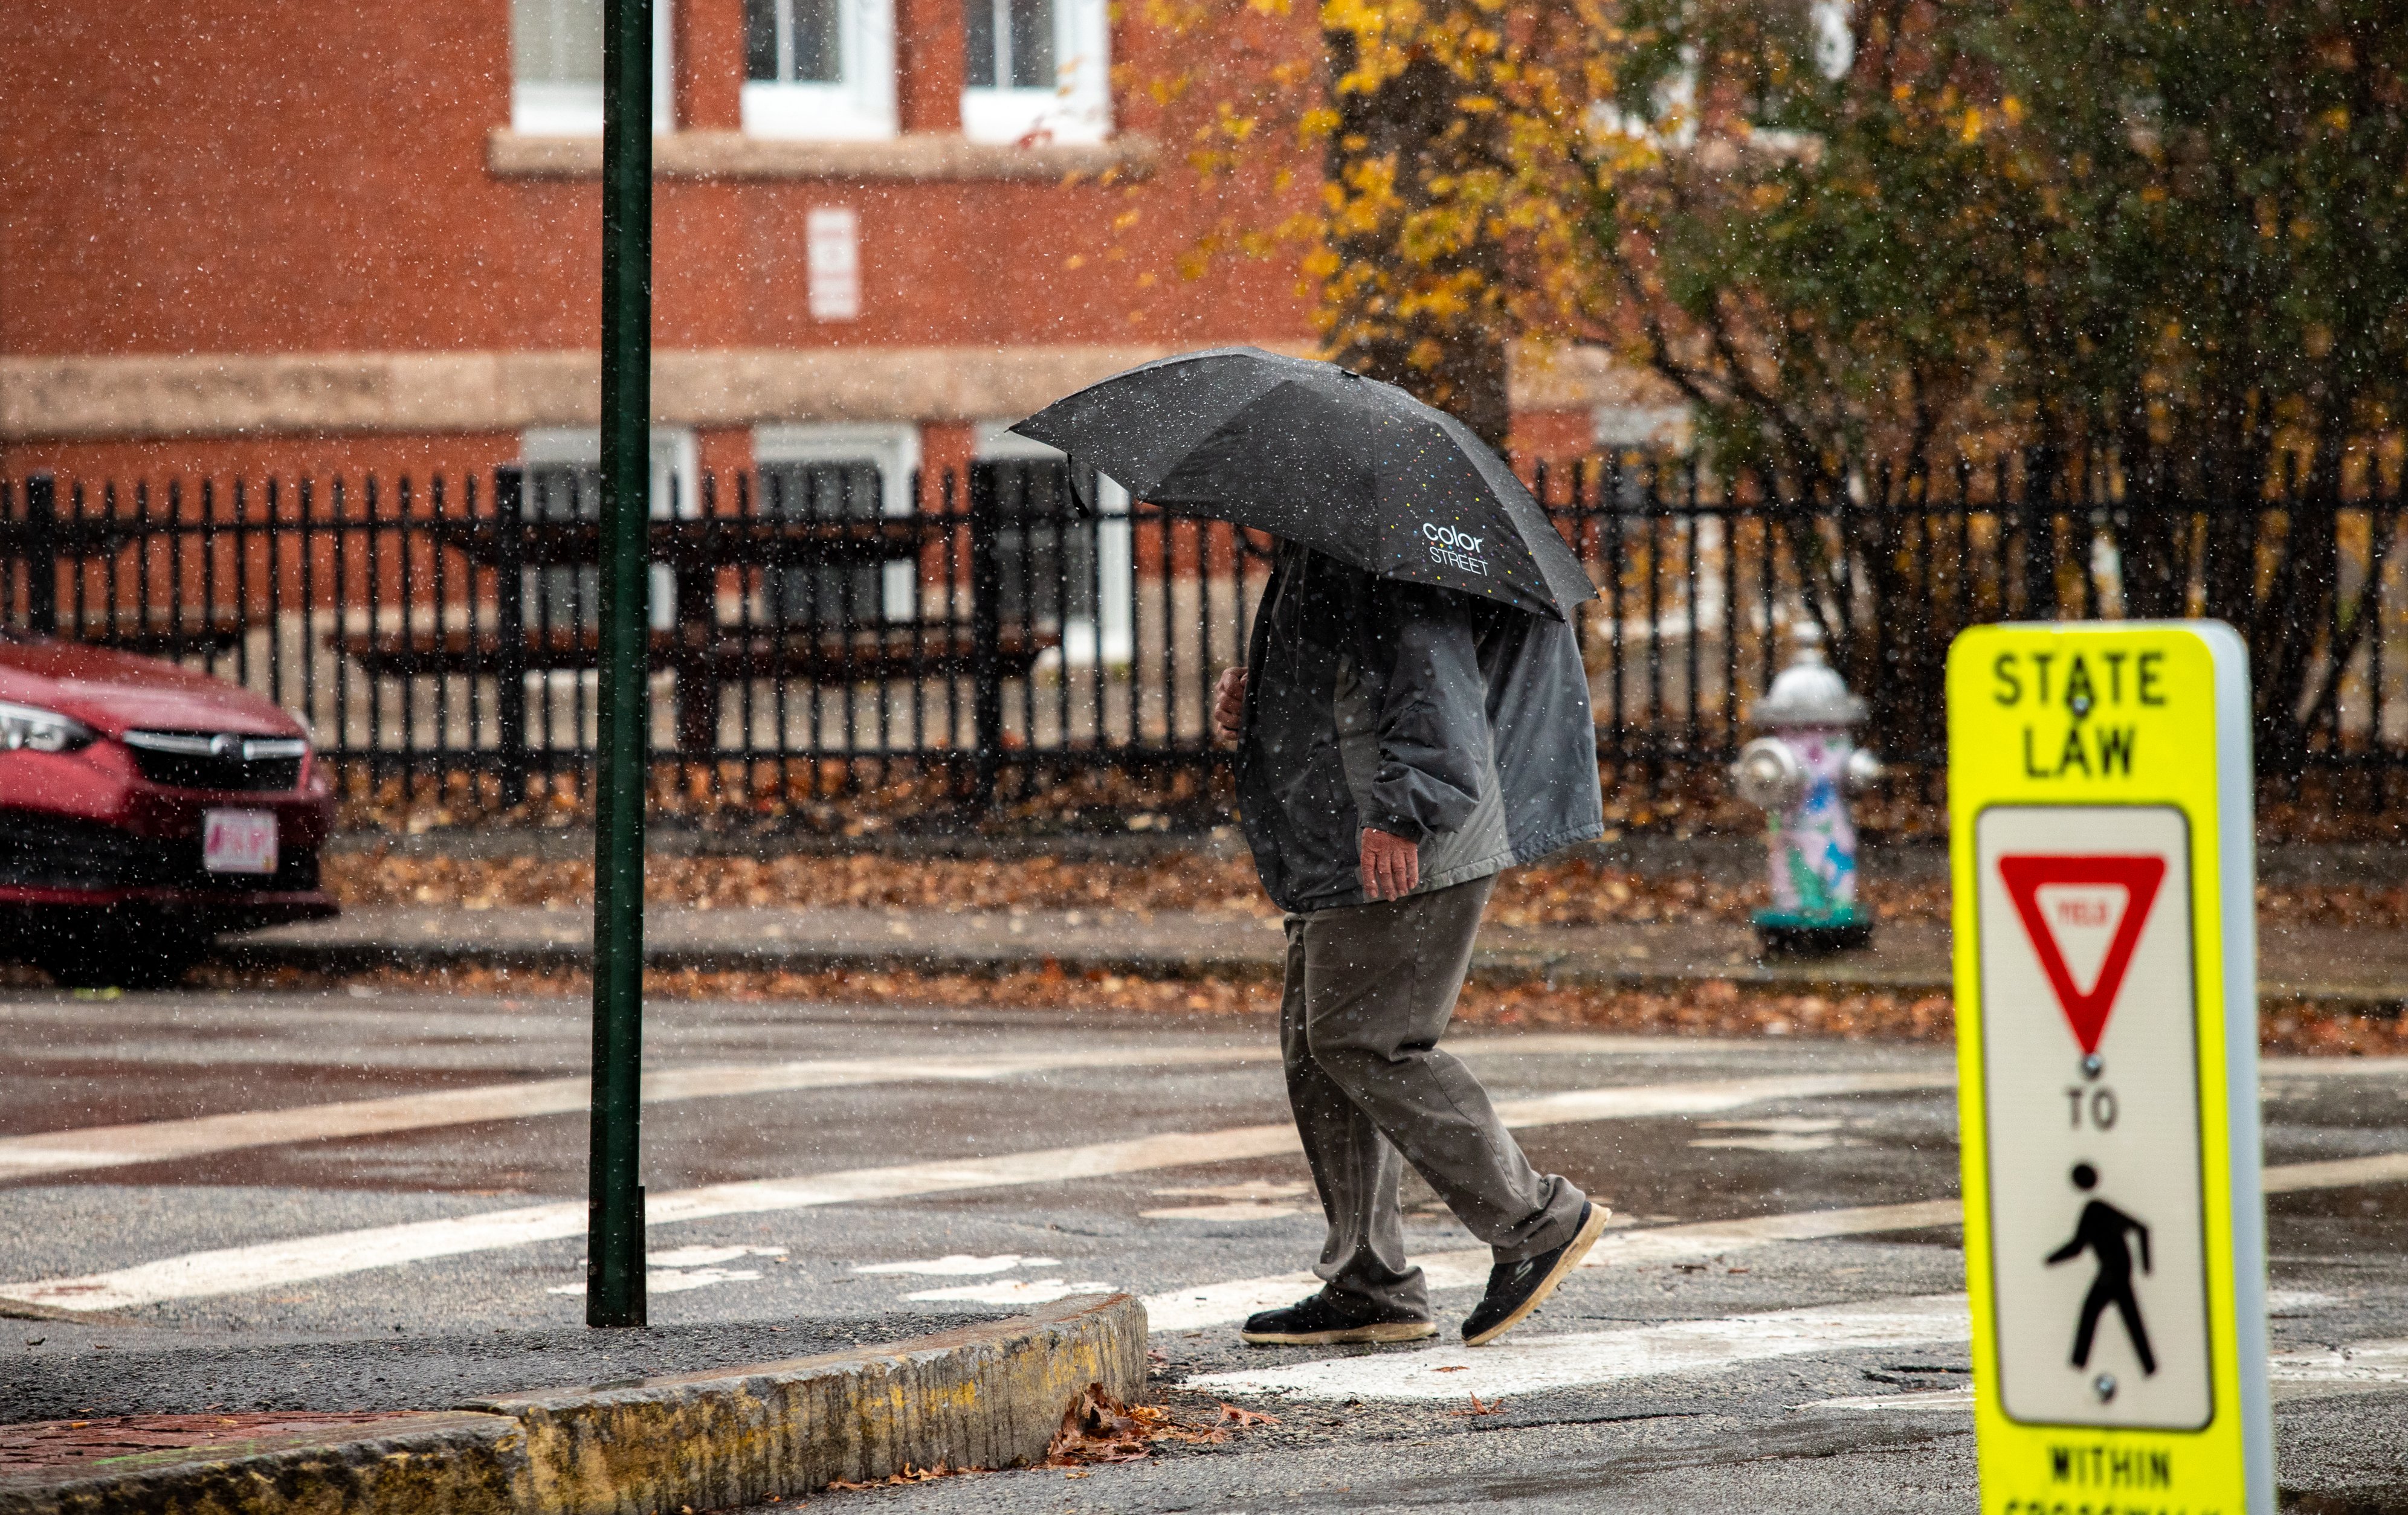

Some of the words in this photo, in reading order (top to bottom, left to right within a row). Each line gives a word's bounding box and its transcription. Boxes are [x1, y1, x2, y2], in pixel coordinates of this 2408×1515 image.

[1422, 523, 1484, 553] color
[1429, 546, 1488, 576] STREET
[1992, 651, 2168, 708] STATE
[2022, 726, 2135, 777] LAW
[2064, 1086, 2119, 1131] TO
[2047, 1444, 2172, 1490] WITHIN
